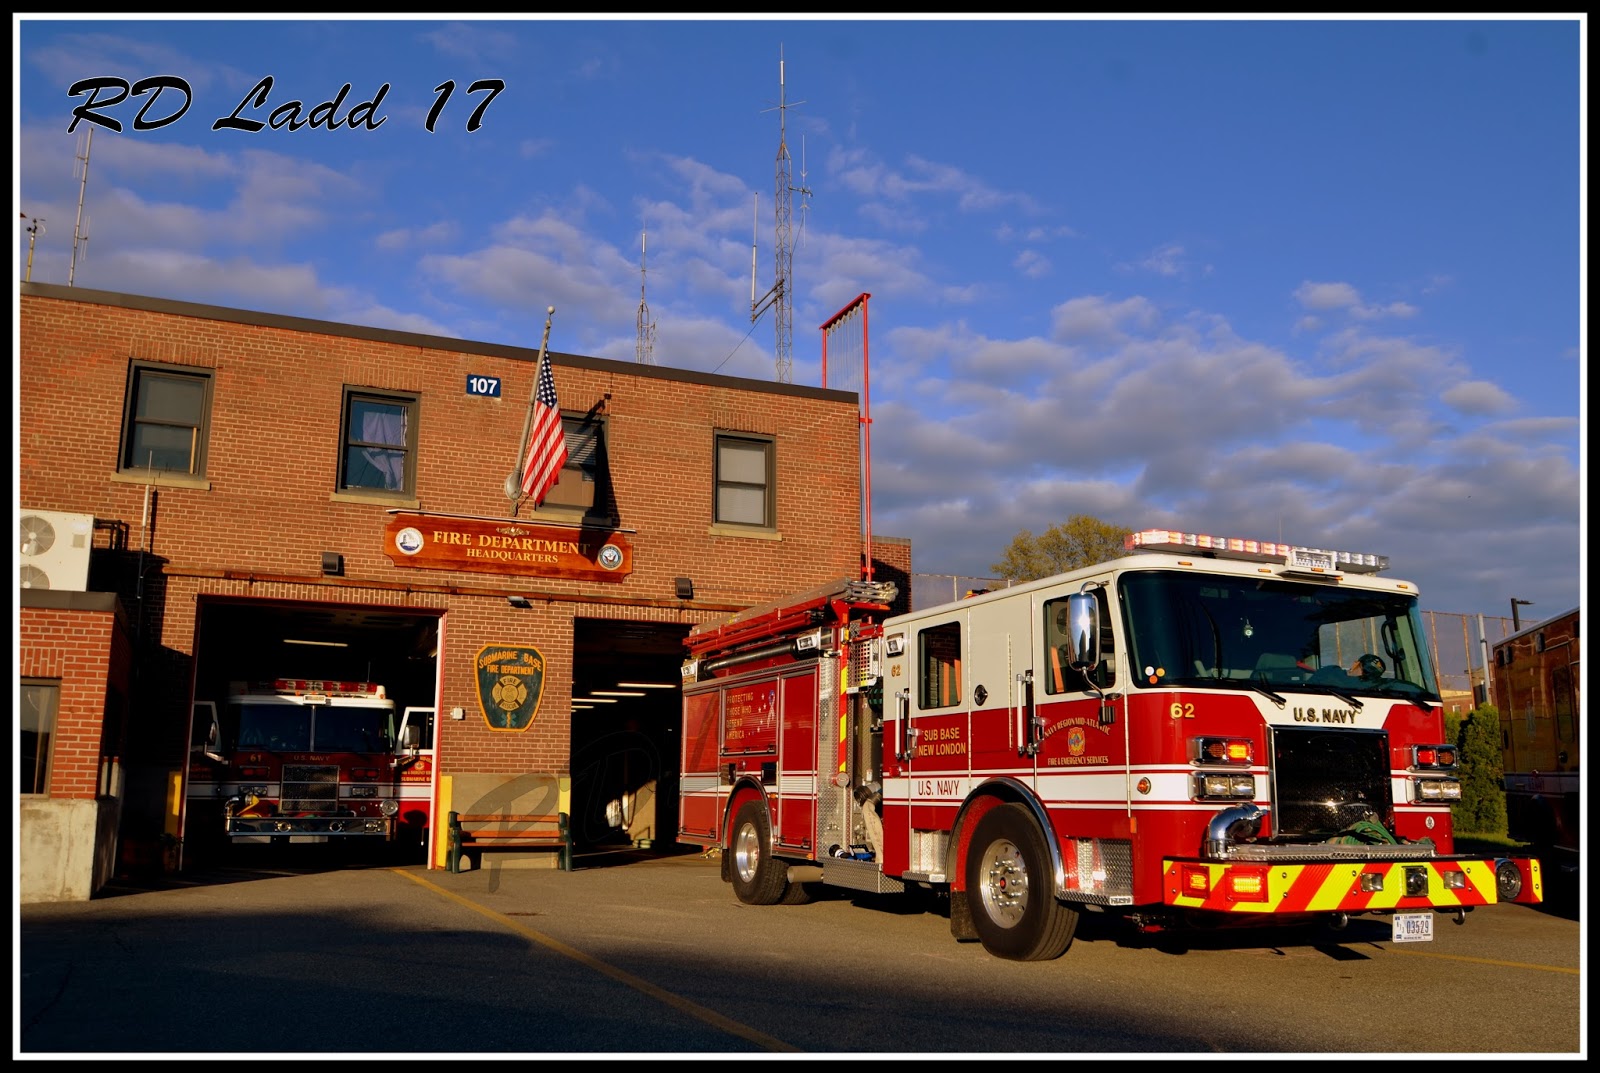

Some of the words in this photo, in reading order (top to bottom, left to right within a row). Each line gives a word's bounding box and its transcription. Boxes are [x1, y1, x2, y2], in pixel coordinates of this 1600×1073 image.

[469, 377, 498, 395] 107
[433, 531, 472, 546] FIRE
[478, 535, 590, 556] DEPARTMENT
[466, 548, 558, 564] HEADQUARTERS
[479, 651, 518, 669] SUBMARINE
[523, 653, 542, 672] BASE
[487, 665, 499, 673] FIRE
[501, 666, 534, 675] DEPARTMENT
[891, 664, 901, 677] 62
[1170, 702, 1195, 719] 62
[1293, 707, 1320, 722] U.S.
[1322, 708, 1356, 724] NAVY
[924, 730, 938, 741] SUB
[940, 727, 960, 740] BASE
[1044, 724, 1057, 738] NAVY
[1057, 718, 1075, 729] REGION
[919, 745, 934, 756] NEW
[936, 742, 966, 755] LONDON
[250, 753, 261, 762] 61
[1087, 756, 1108, 764] SERVICES
[917, 781, 934, 796] U.S.
[937, 780, 960, 796] NAVY
[1406, 920, 1430, 934] 03529
